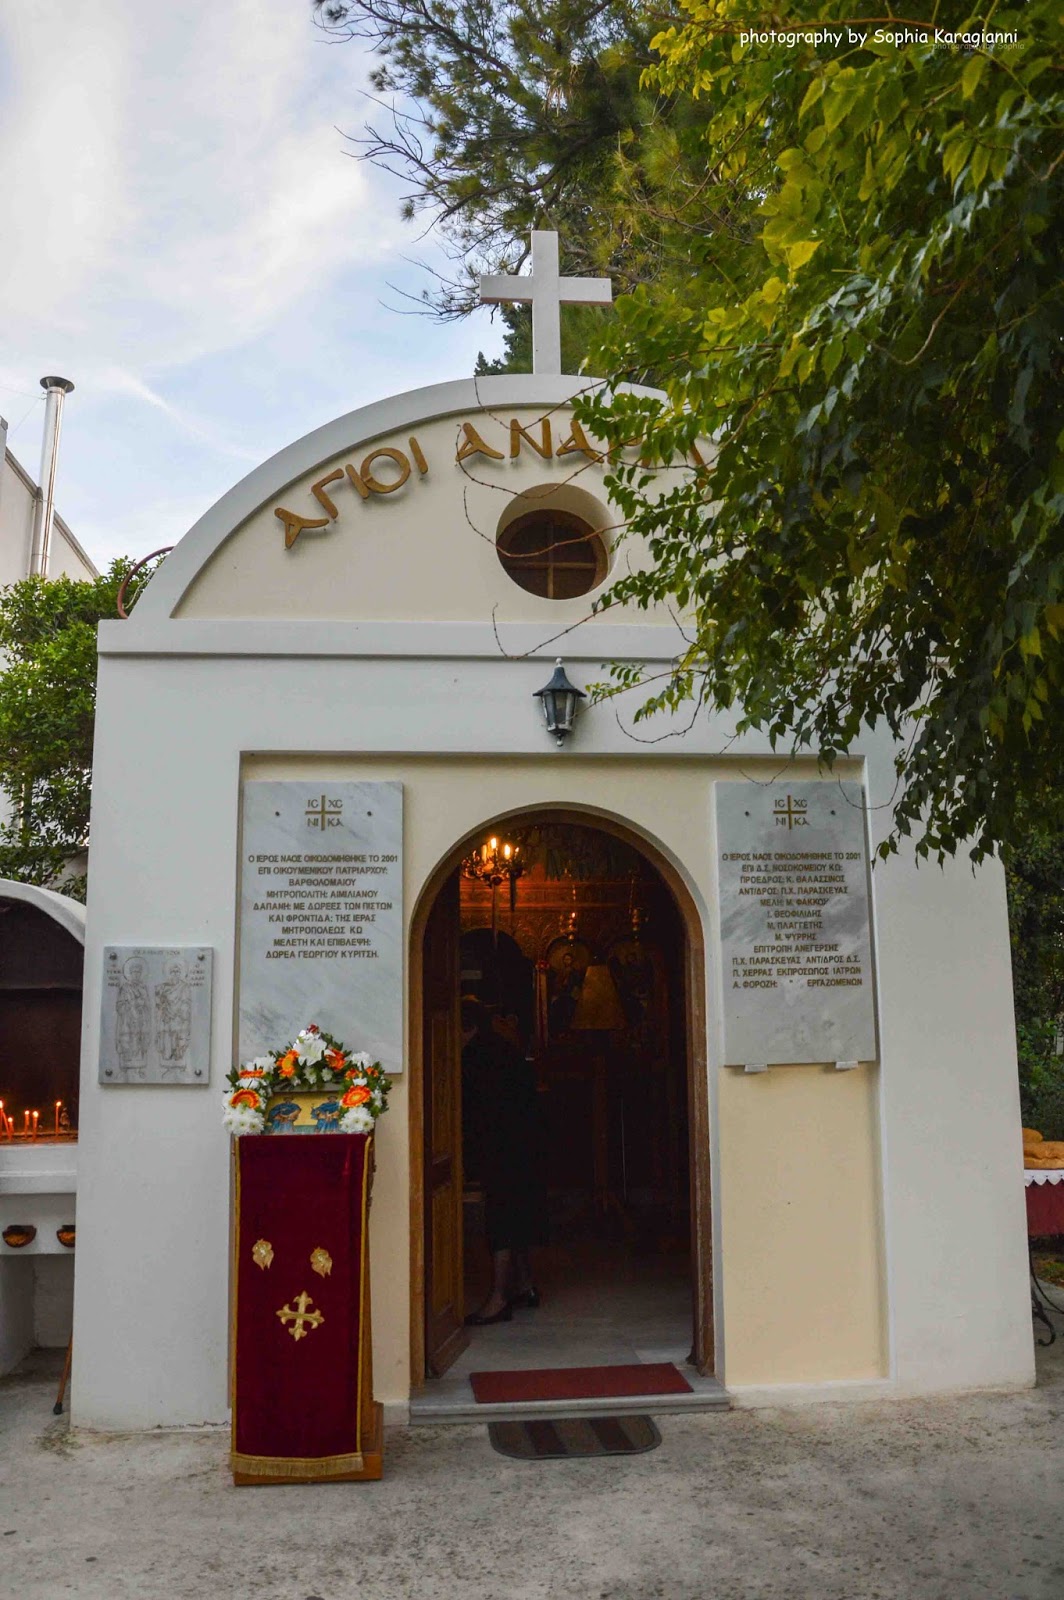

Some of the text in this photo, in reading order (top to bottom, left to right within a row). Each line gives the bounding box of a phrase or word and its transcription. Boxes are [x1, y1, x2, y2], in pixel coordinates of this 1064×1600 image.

[274, 437, 429, 548] ΑΓΙΟΙ
[798, 886, 848, 894] ΠΑΡΑΣΚΕΥΑΣ
[774, 910, 822, 918] ΘΕΟΦΙΛΙΔΗΣ
[754, 944, 838, 953] ΕΠΙΤΡΟΠΗ ΑΝΕΓΕΡΣΗΣ
[750, 956, 801, 964] ΠΑΡΑΣΚΕΥΑΣ
[777, 968, 829, 976] ΕΚΠΡΟΣΩΠΟΣ
[807, 979, 862, 987] ΕΡΓΑΖΟΜΕΝΩΝ
